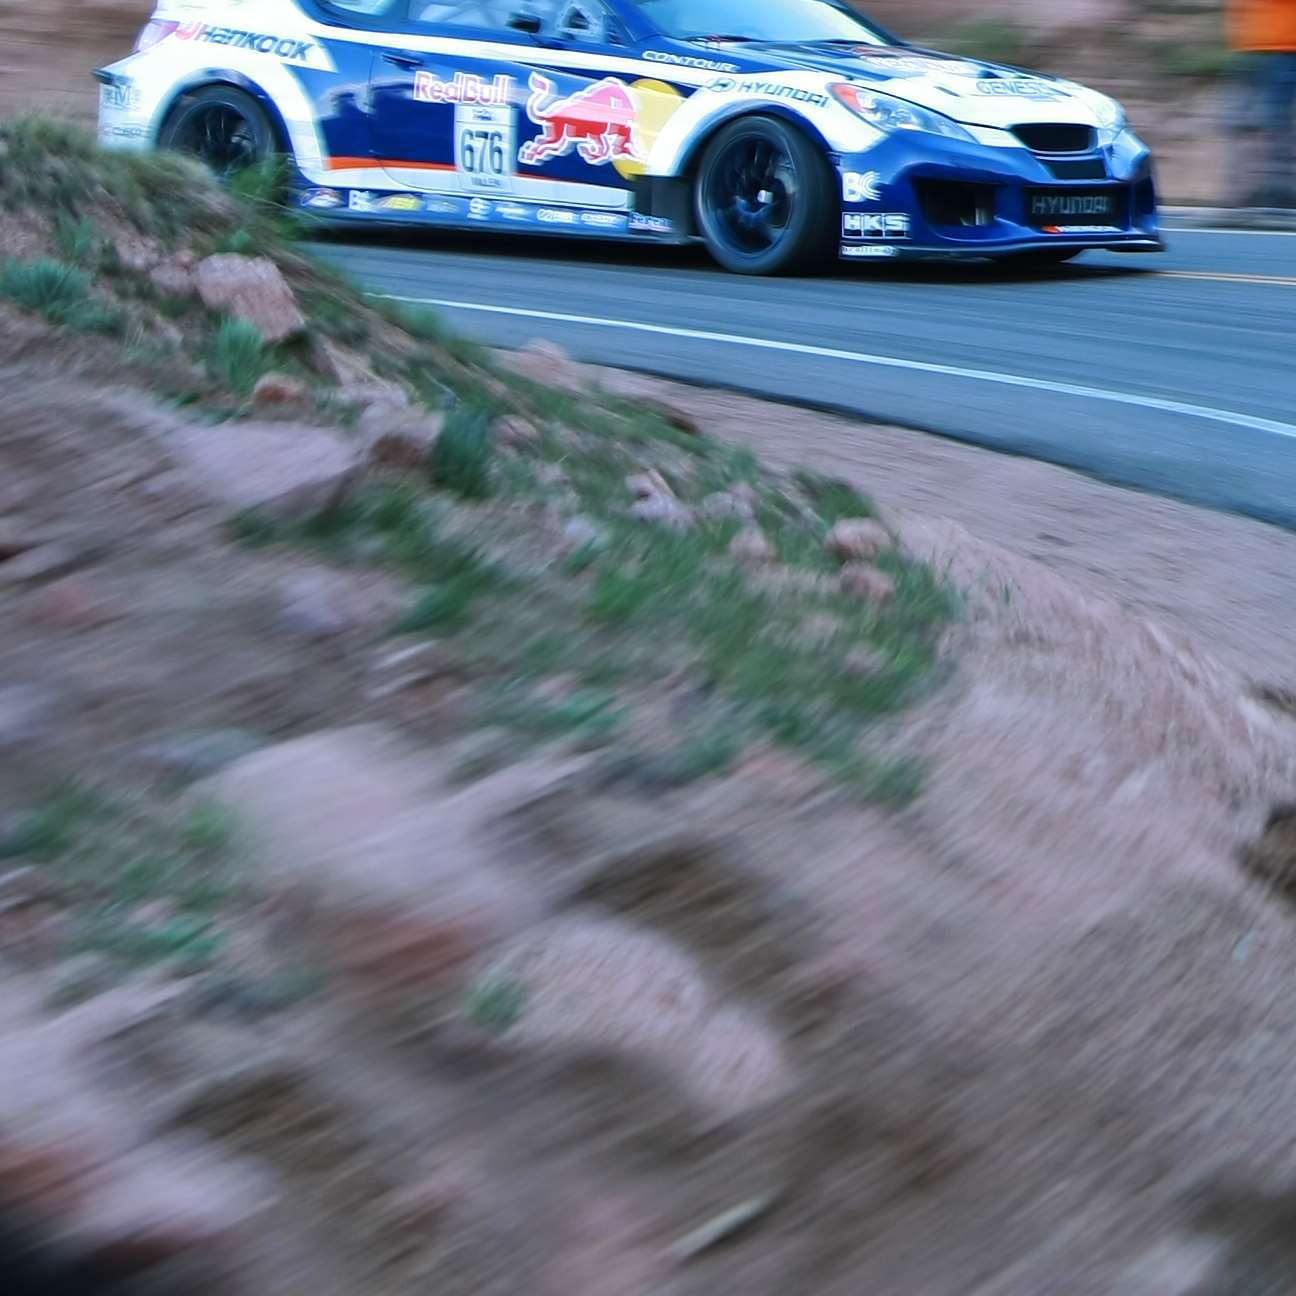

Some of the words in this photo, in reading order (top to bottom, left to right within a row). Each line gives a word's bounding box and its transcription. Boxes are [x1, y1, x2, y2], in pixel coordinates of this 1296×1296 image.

[642, 50, 740, 72] CONTOUR
[736, 81, 830, 108] HYUNDAI
[461, 128, 503, 174] 676
[843, 213, 911, 233] HKS
